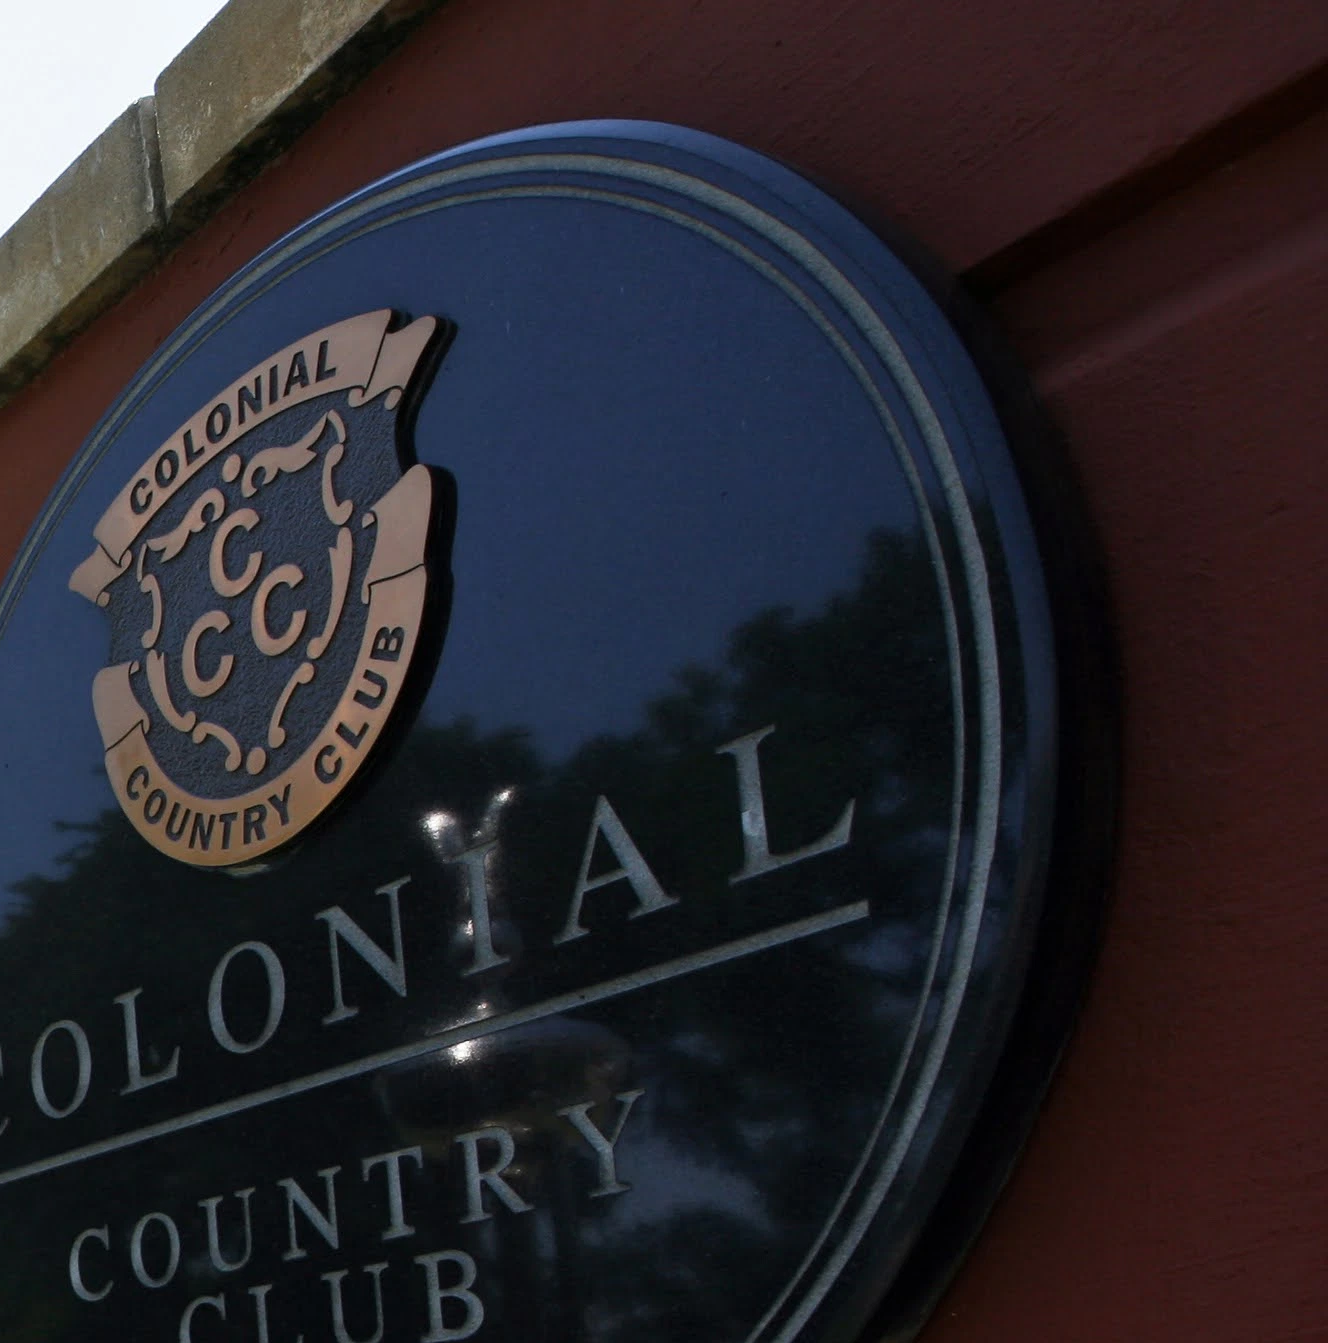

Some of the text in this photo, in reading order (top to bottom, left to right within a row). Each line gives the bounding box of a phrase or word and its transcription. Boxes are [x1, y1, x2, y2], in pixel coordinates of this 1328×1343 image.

[129, 339, 337, 517] COLONIAL
[182, 564, 307, 697] C C
[209, 508, 263, 597] C
[126, 624, 405, 852] COUNTRY CLUB
[67, 1088, 646, 1301] COUNTRY
